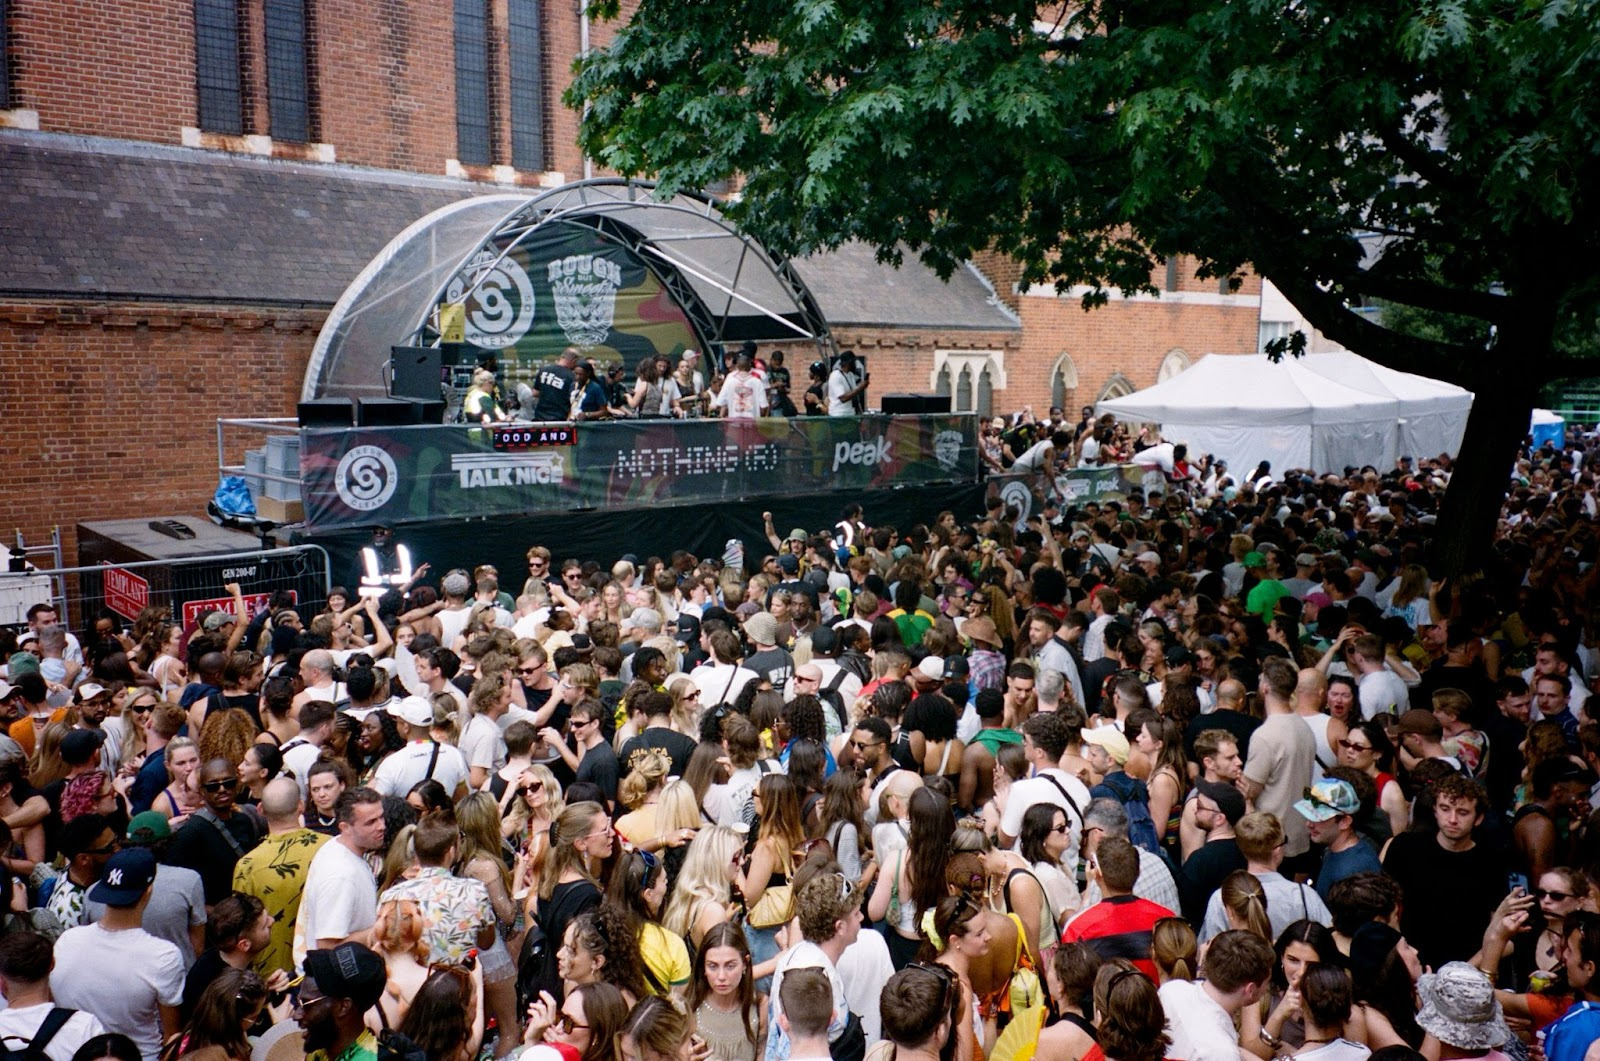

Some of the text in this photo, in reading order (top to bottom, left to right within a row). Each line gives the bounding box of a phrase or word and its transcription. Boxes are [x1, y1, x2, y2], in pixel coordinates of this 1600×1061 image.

[471, 333, 514, 346] CLEAN
[540, 431, 567, 442] AND
[350, 447, 382, 458] FRESH
[832, 435, 892, 472] peak
[617, 445, 738, 478] NOTHING
[452, 463, 513, 488] TALK
[351, 498, 383, 508] CLEAN
[222, 568, 235, 579] GEN
[107, 569, 146, 605] TEMPLANT
